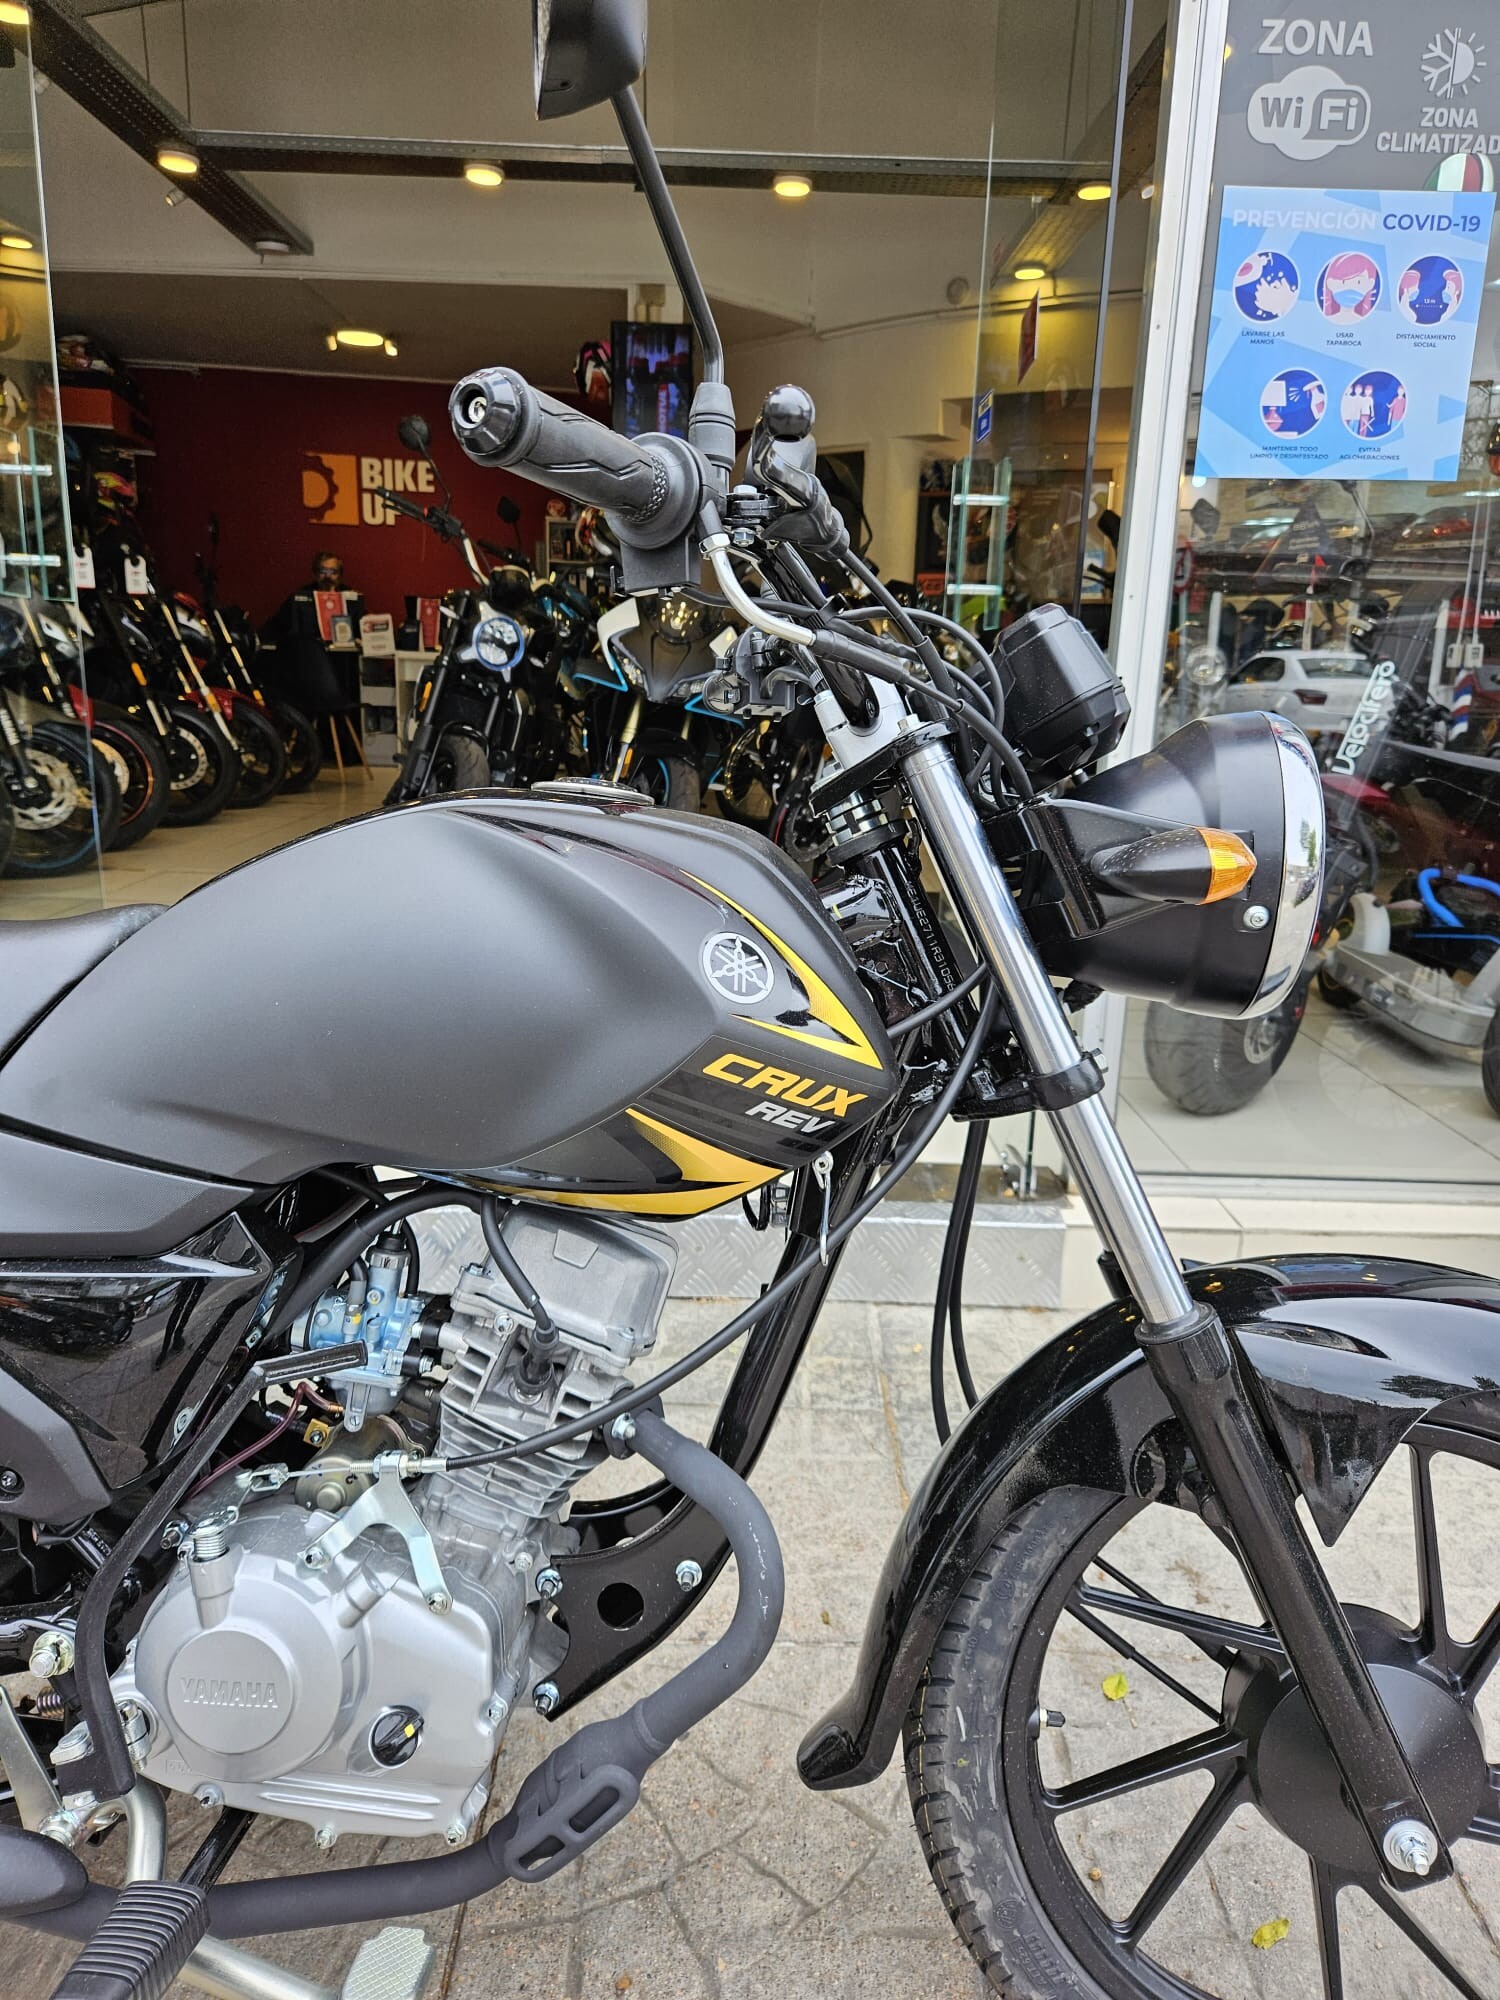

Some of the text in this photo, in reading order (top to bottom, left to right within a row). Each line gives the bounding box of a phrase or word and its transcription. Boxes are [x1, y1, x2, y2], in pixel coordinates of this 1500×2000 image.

[1258, 19, 1374, 56] ZONA
[1260, 96, 1359, 131] WiFi
[1420, 107, 1479, 128] ZONA
[1376, 131, 1500, 154] CLIMATIZAD
[1232, 208, 1481, 232] PREVENCIÓN COVID-19
[1396, 333, 1456, 341] DISTANCIAMIENTO
[360, 456, 436, 493] BIKE
[702, 1053, 869, 1117] CRUX
[745, 1101, 836, 1133] REV
[180, 1678, 278, 1708] YAMAHA
